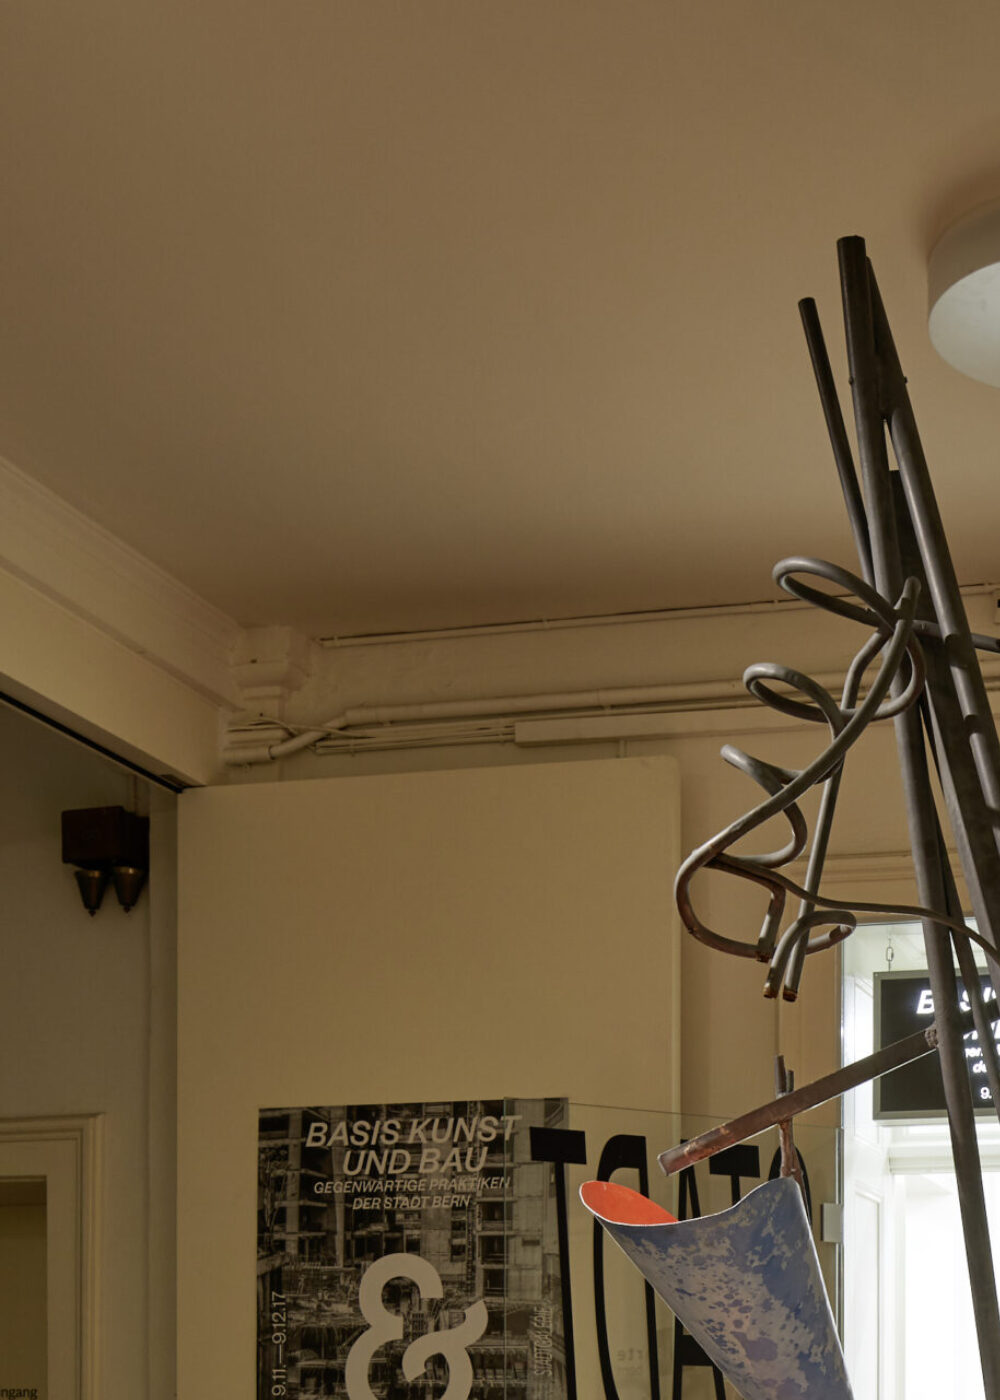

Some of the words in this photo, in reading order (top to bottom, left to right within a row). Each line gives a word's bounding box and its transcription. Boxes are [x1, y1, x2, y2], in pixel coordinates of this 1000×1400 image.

[306, 1120, 400, 1147] BASIS
[408, 1115, 523, 1144] KUNST
[342, 1149, 411, 1175] UND
[418, 1146, 488, 1173] BAU
[429, 1177, 511, 1192] PRAKTIKEN
[352, 1197, 381, 1210] DER
[384, 1196, 430, 1209] STADT
[432, 1195, 471, 1208] BERN
